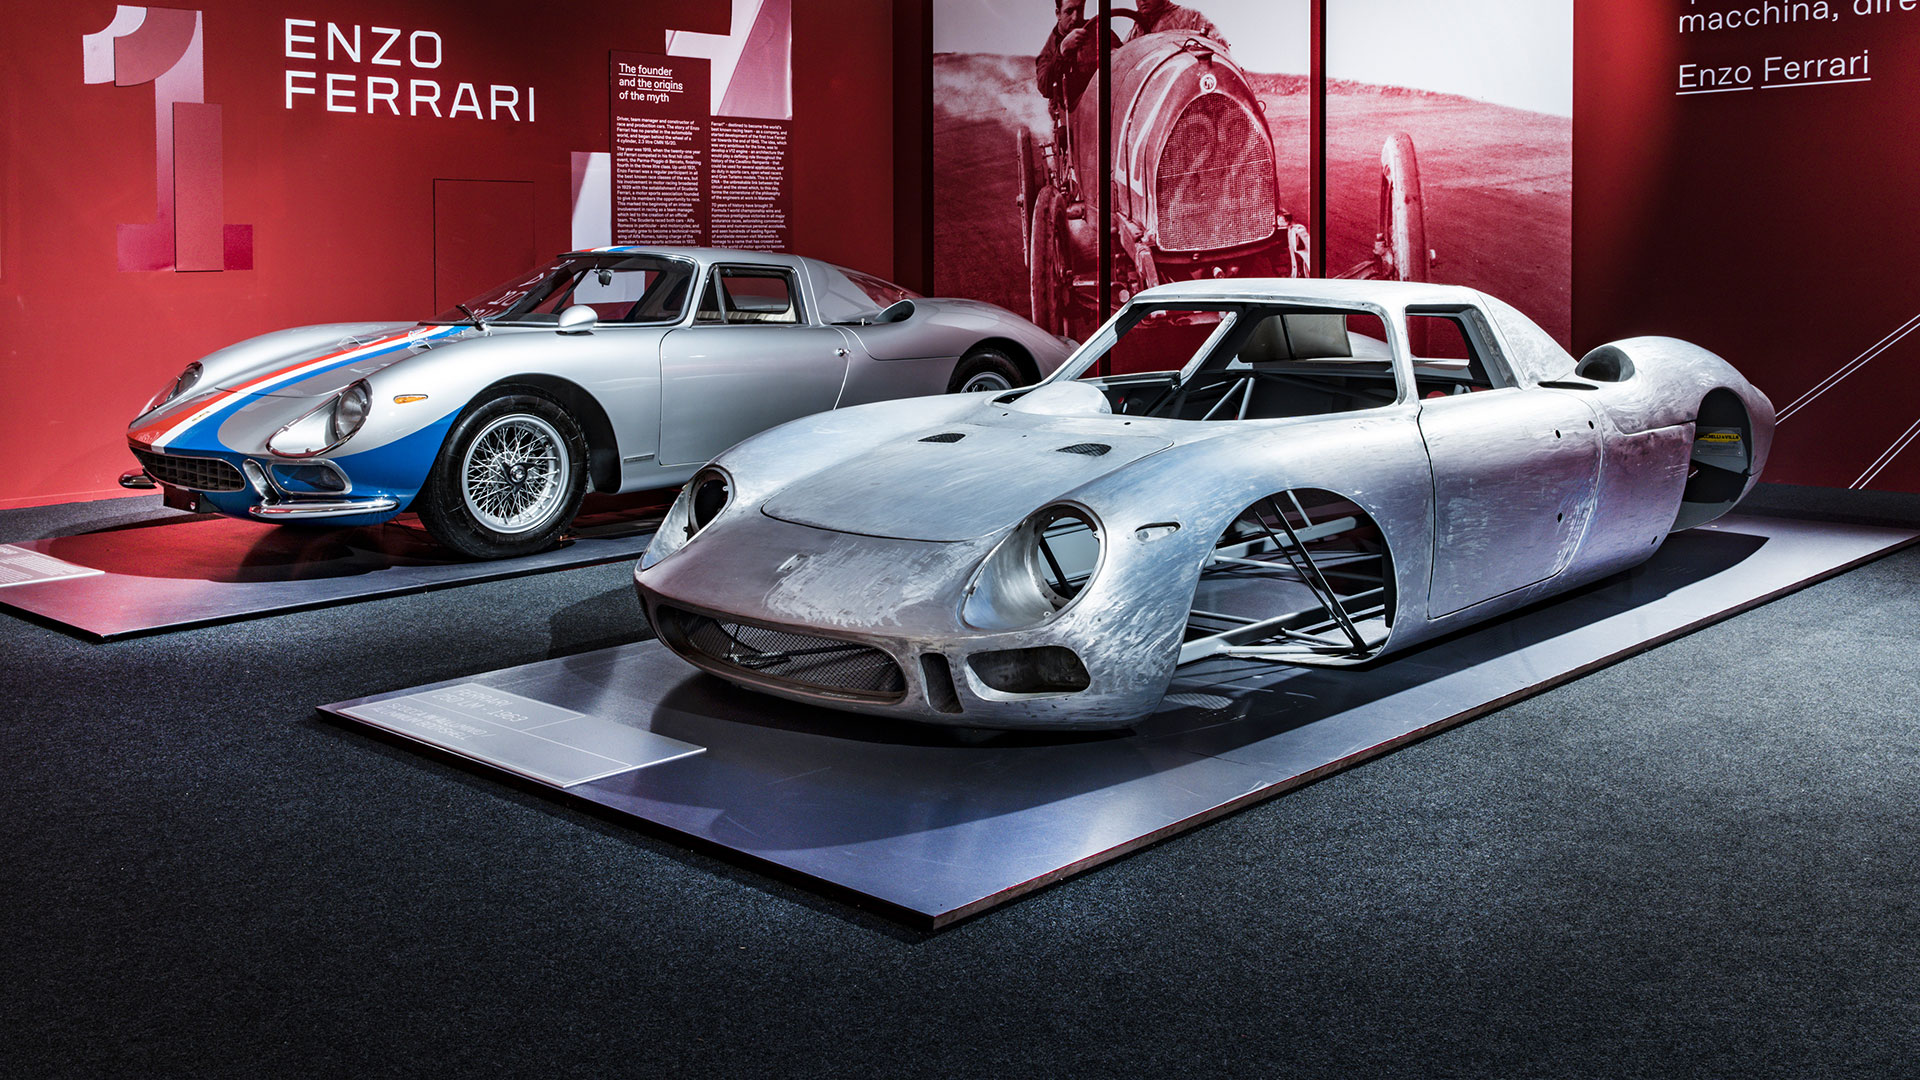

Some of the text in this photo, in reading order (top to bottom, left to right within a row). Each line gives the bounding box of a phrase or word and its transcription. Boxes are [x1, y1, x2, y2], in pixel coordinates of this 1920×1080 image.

[1679, 0, 1839, 33] macchina,
[285, 18, 442, 69] ENZO
[619, 63, 672, 76] The founder
[619, 77, 683, 92] and the origins
[1679, 49, 1869, 88] Enzo Ferrari
[285, 69, 535, 122] FERRARI
[619, 91, 670, 103] of the myth
